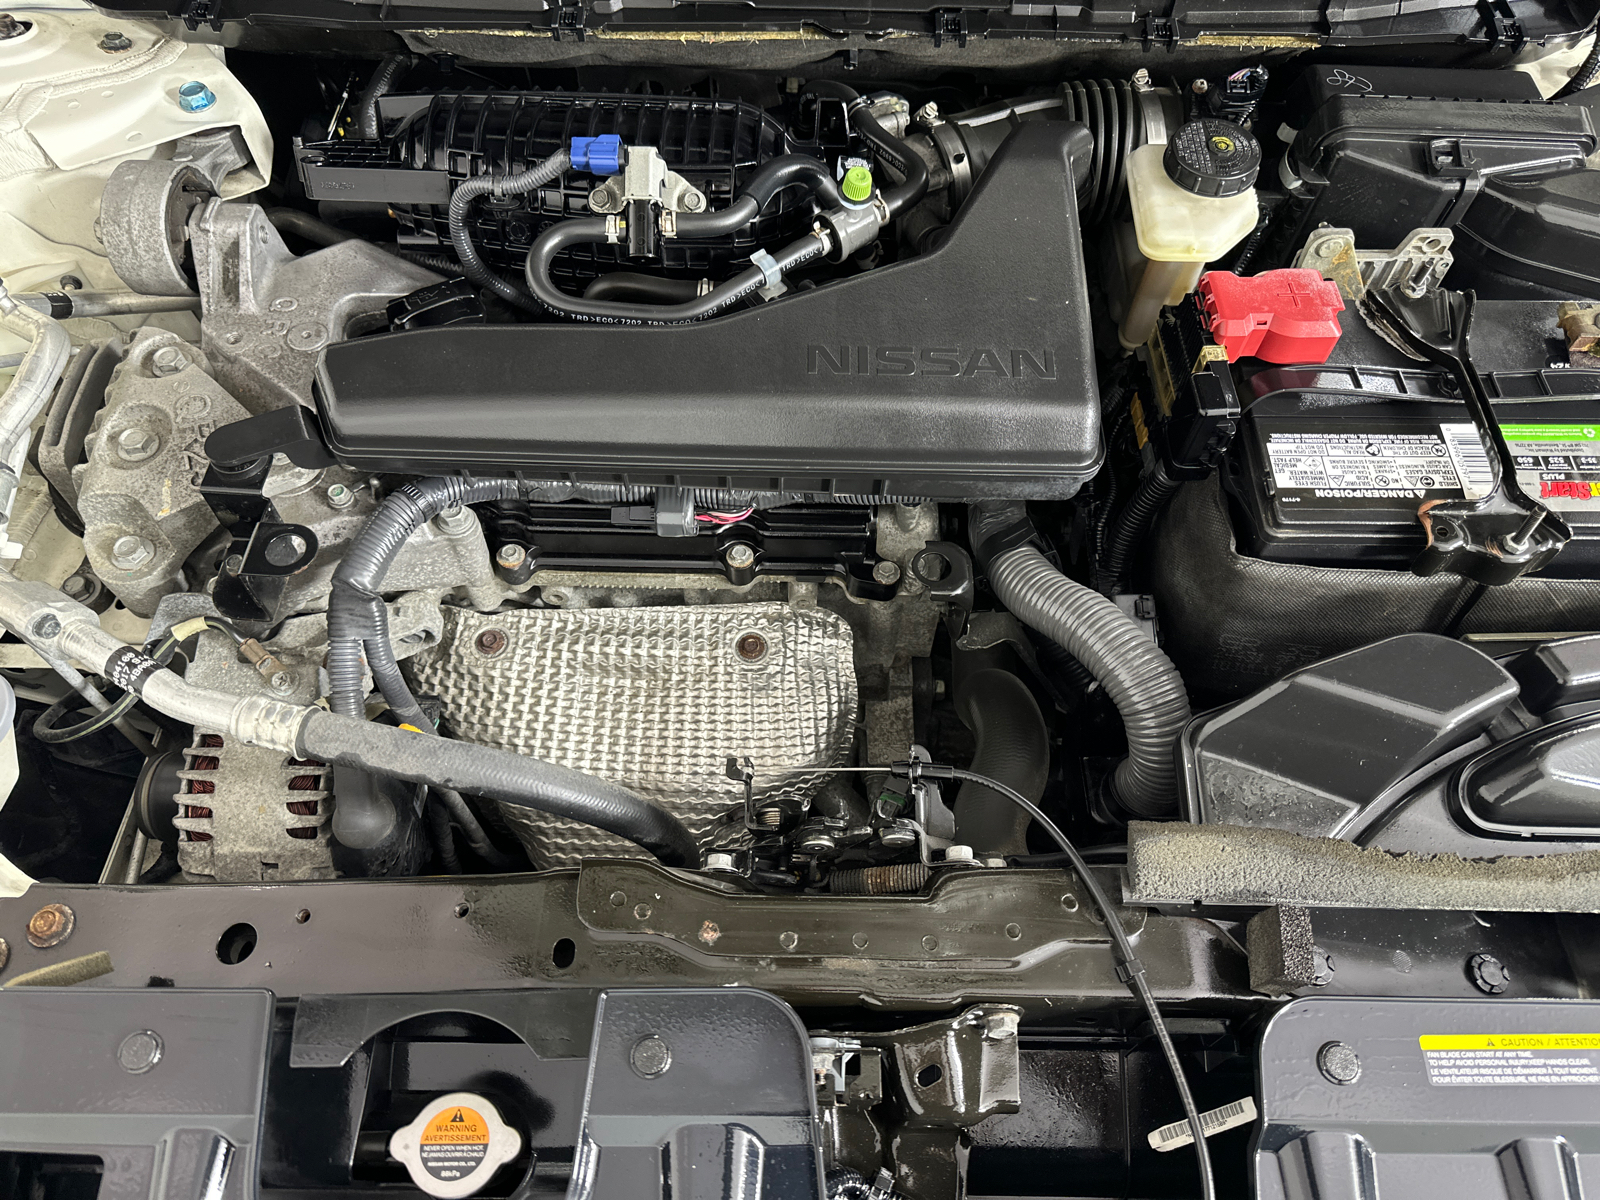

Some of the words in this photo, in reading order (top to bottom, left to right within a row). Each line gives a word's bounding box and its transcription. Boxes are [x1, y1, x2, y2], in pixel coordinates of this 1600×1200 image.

[807, 345, 1056, 380] NISSAN
[1314, 489, 1414, 498] DANGER/POISON
[1501, 1038, 1544, 1047] CAUTION
[1554, 1038, 1600, 1046] ATTENTIO
[436, 1124, 477, 1133] WARNING
[440, 1170, 461, 1178] 88kPa
